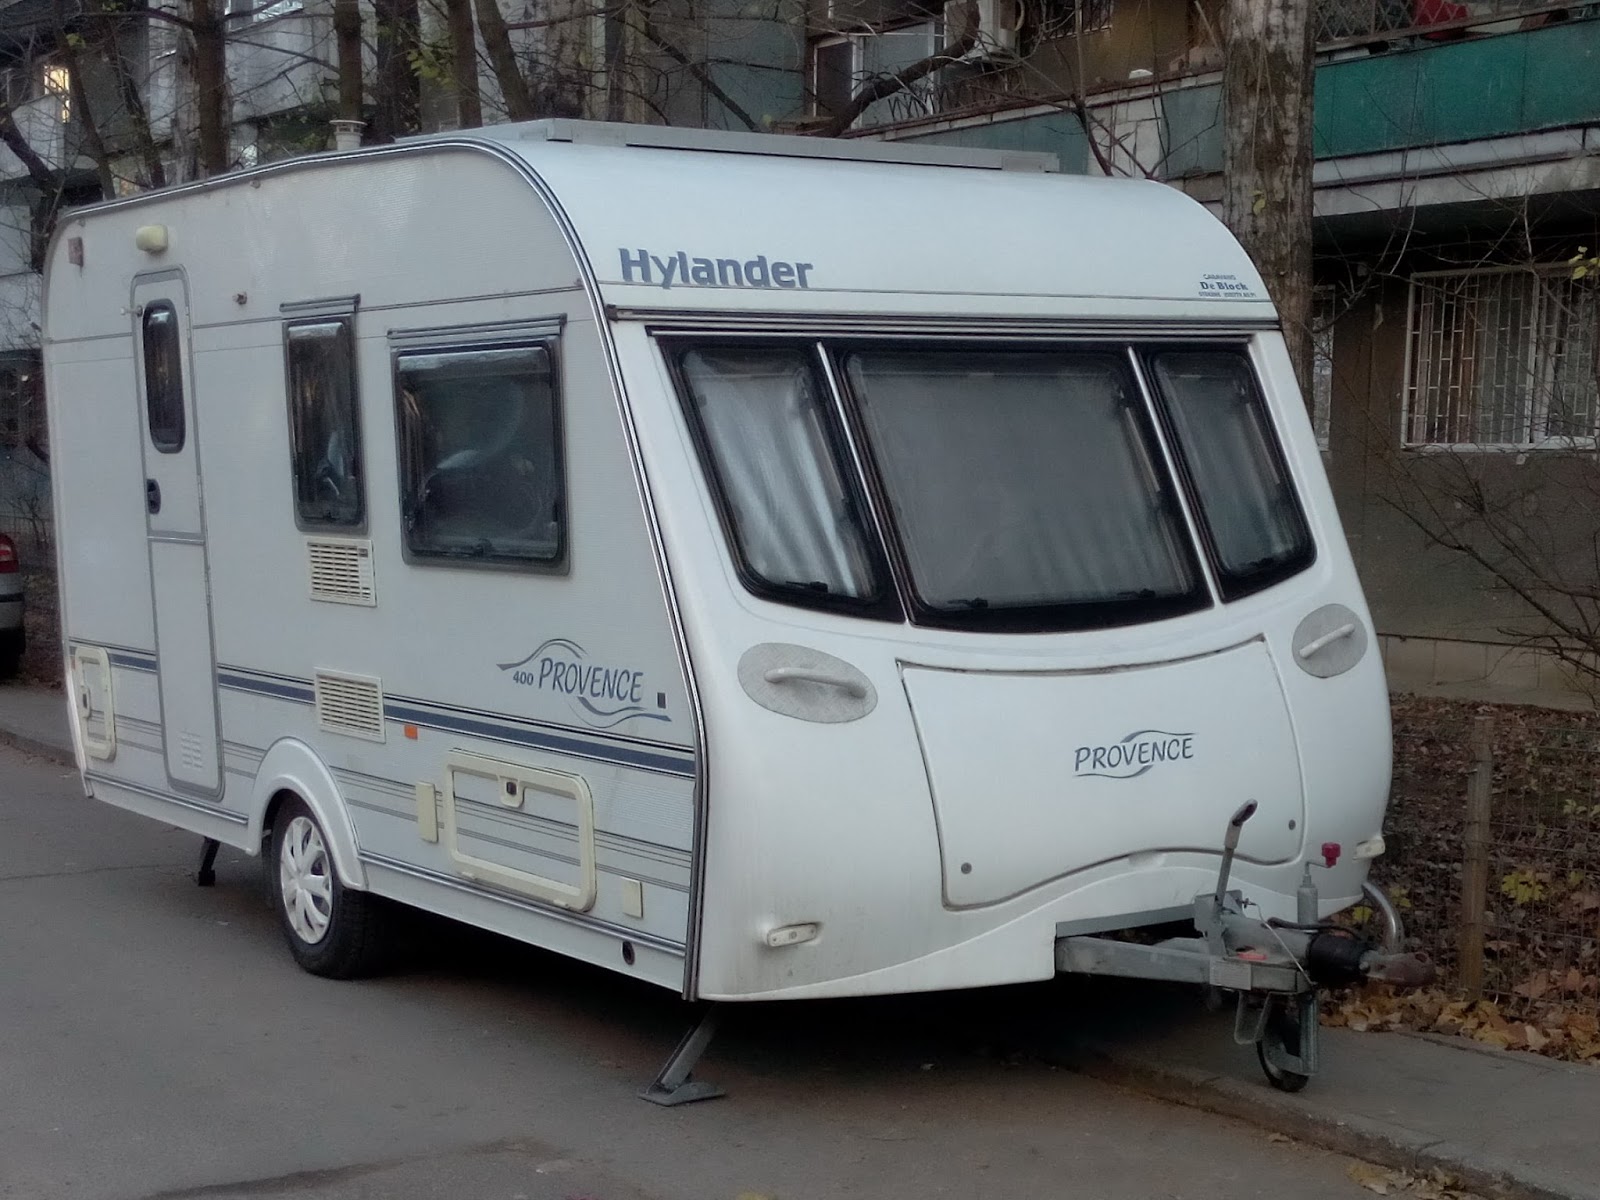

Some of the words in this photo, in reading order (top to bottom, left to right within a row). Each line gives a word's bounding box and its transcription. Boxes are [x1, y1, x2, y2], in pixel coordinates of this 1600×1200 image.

[618, 248, 814, 290] Hylander
[1200, 281, 1216, 290] De
[512, 670, 534, 686] 400
[538, 657, 644, 703] PROVENCE
[1074, 737, 1194, 772] PROVENCE
